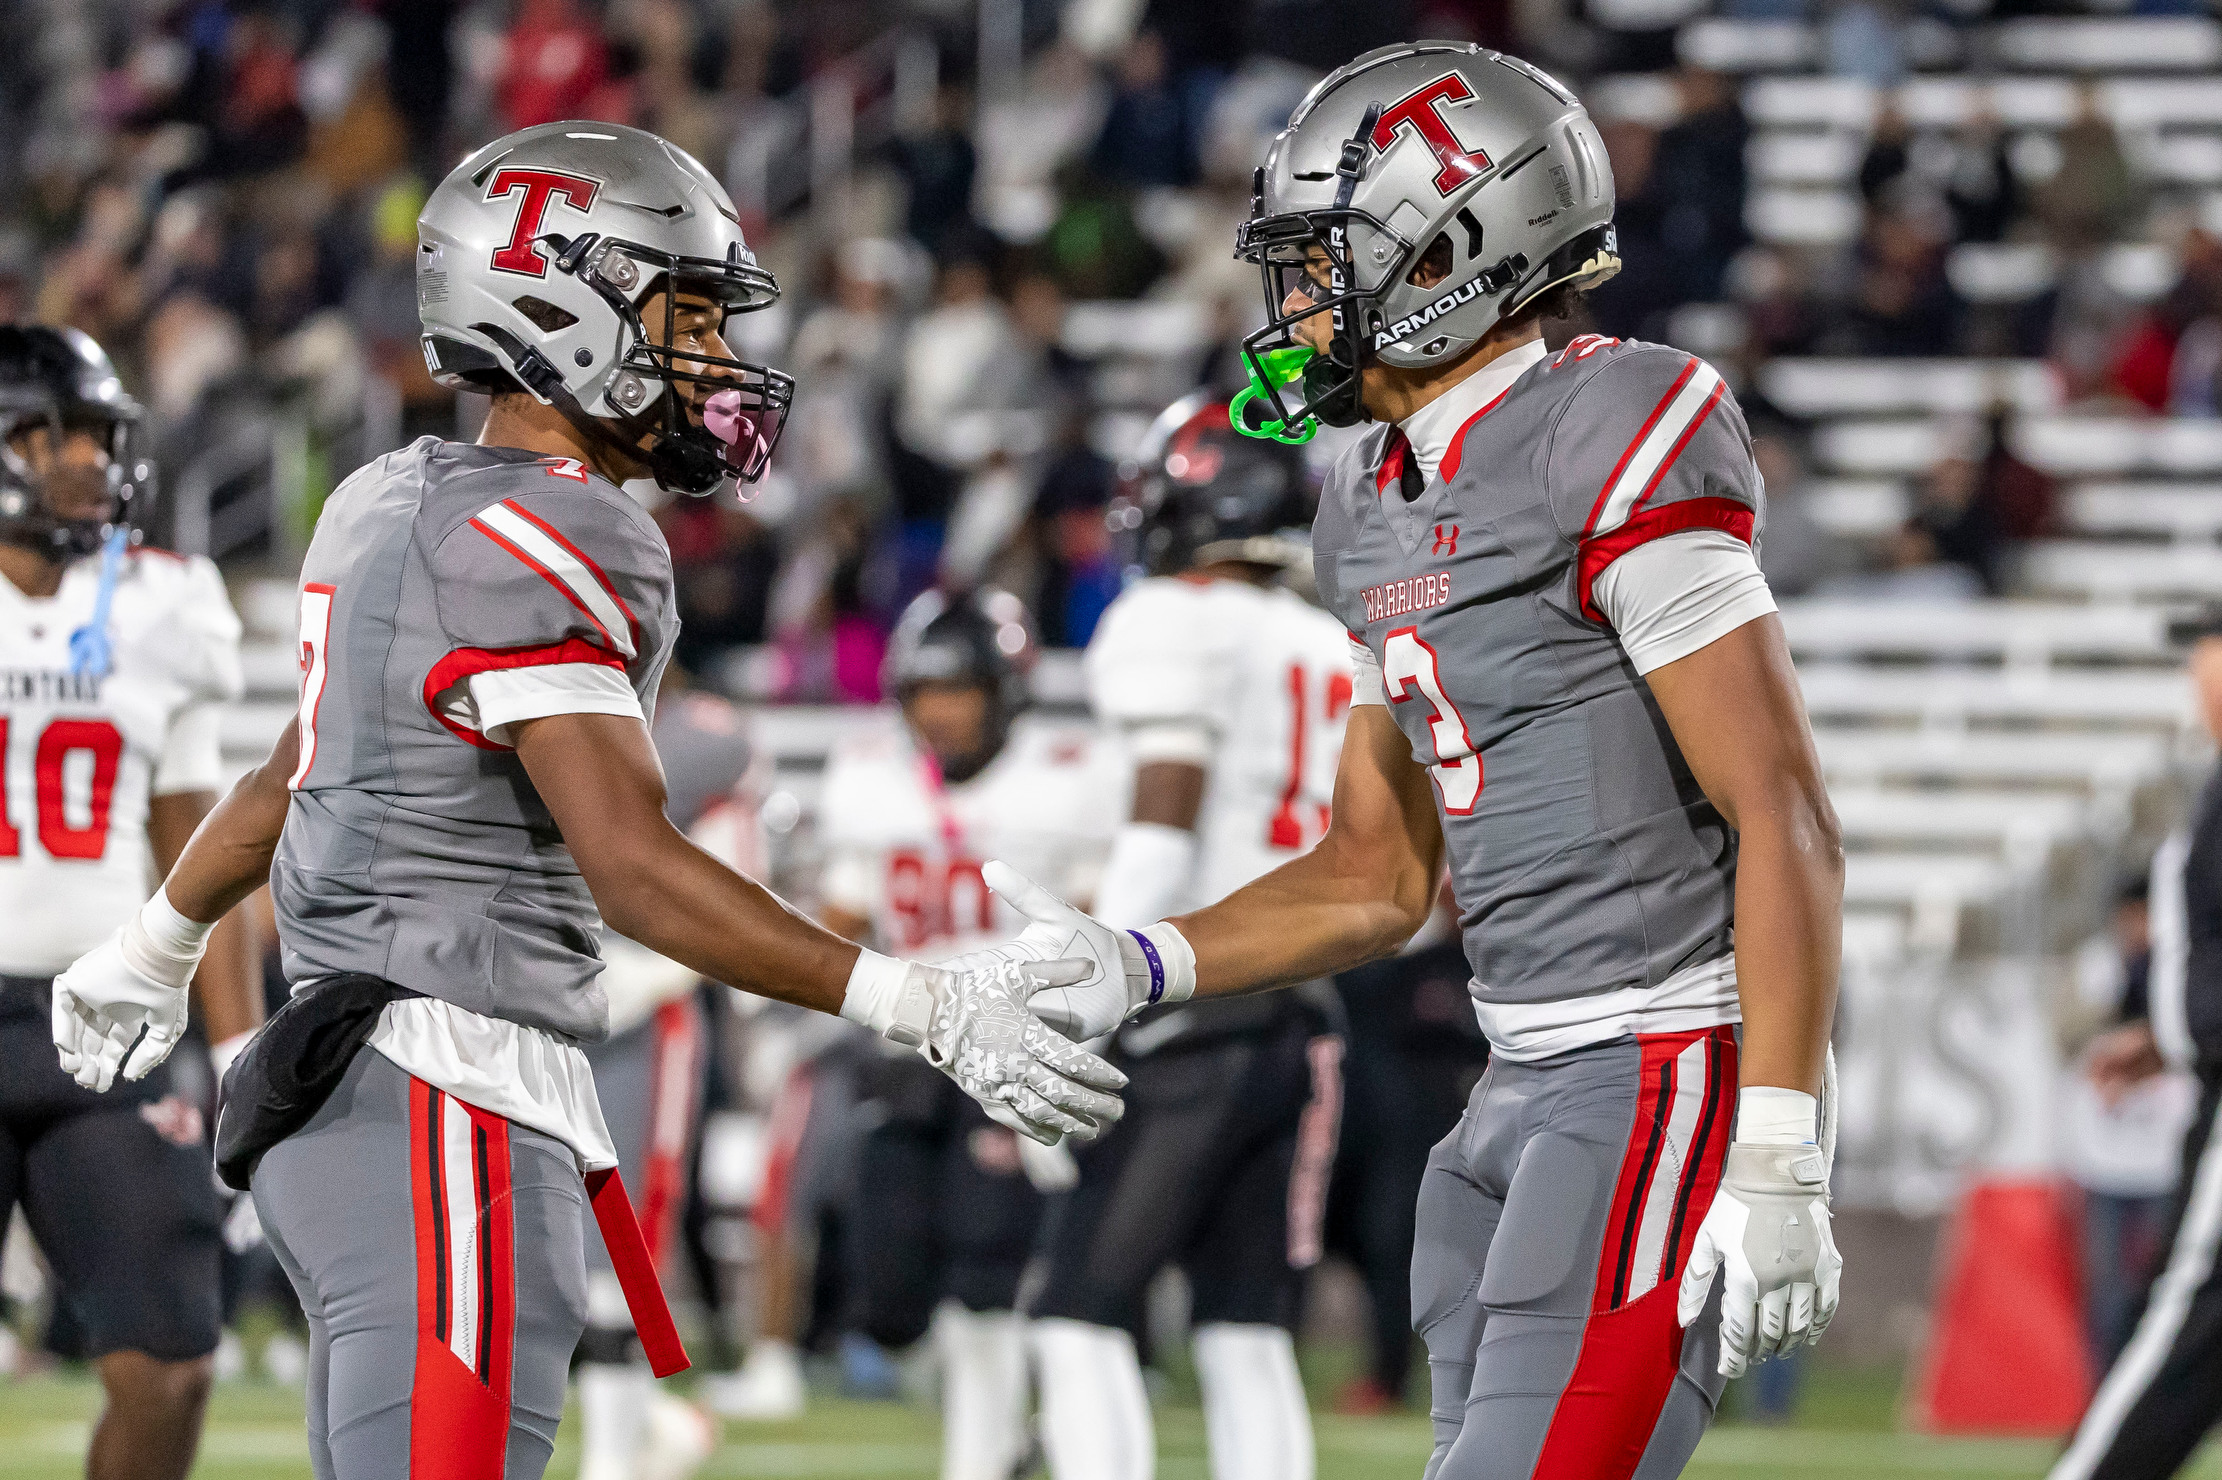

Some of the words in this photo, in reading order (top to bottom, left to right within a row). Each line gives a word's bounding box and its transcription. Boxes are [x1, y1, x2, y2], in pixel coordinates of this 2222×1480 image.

[1368, 69, 1496, 199] T
[483, 165, 604, 283] T
[1375, 275, 1491, 350] ARMOUR
[1360, 571, 1450, 624] WARRIORS
[1383, 625, 1484, 815] 3
